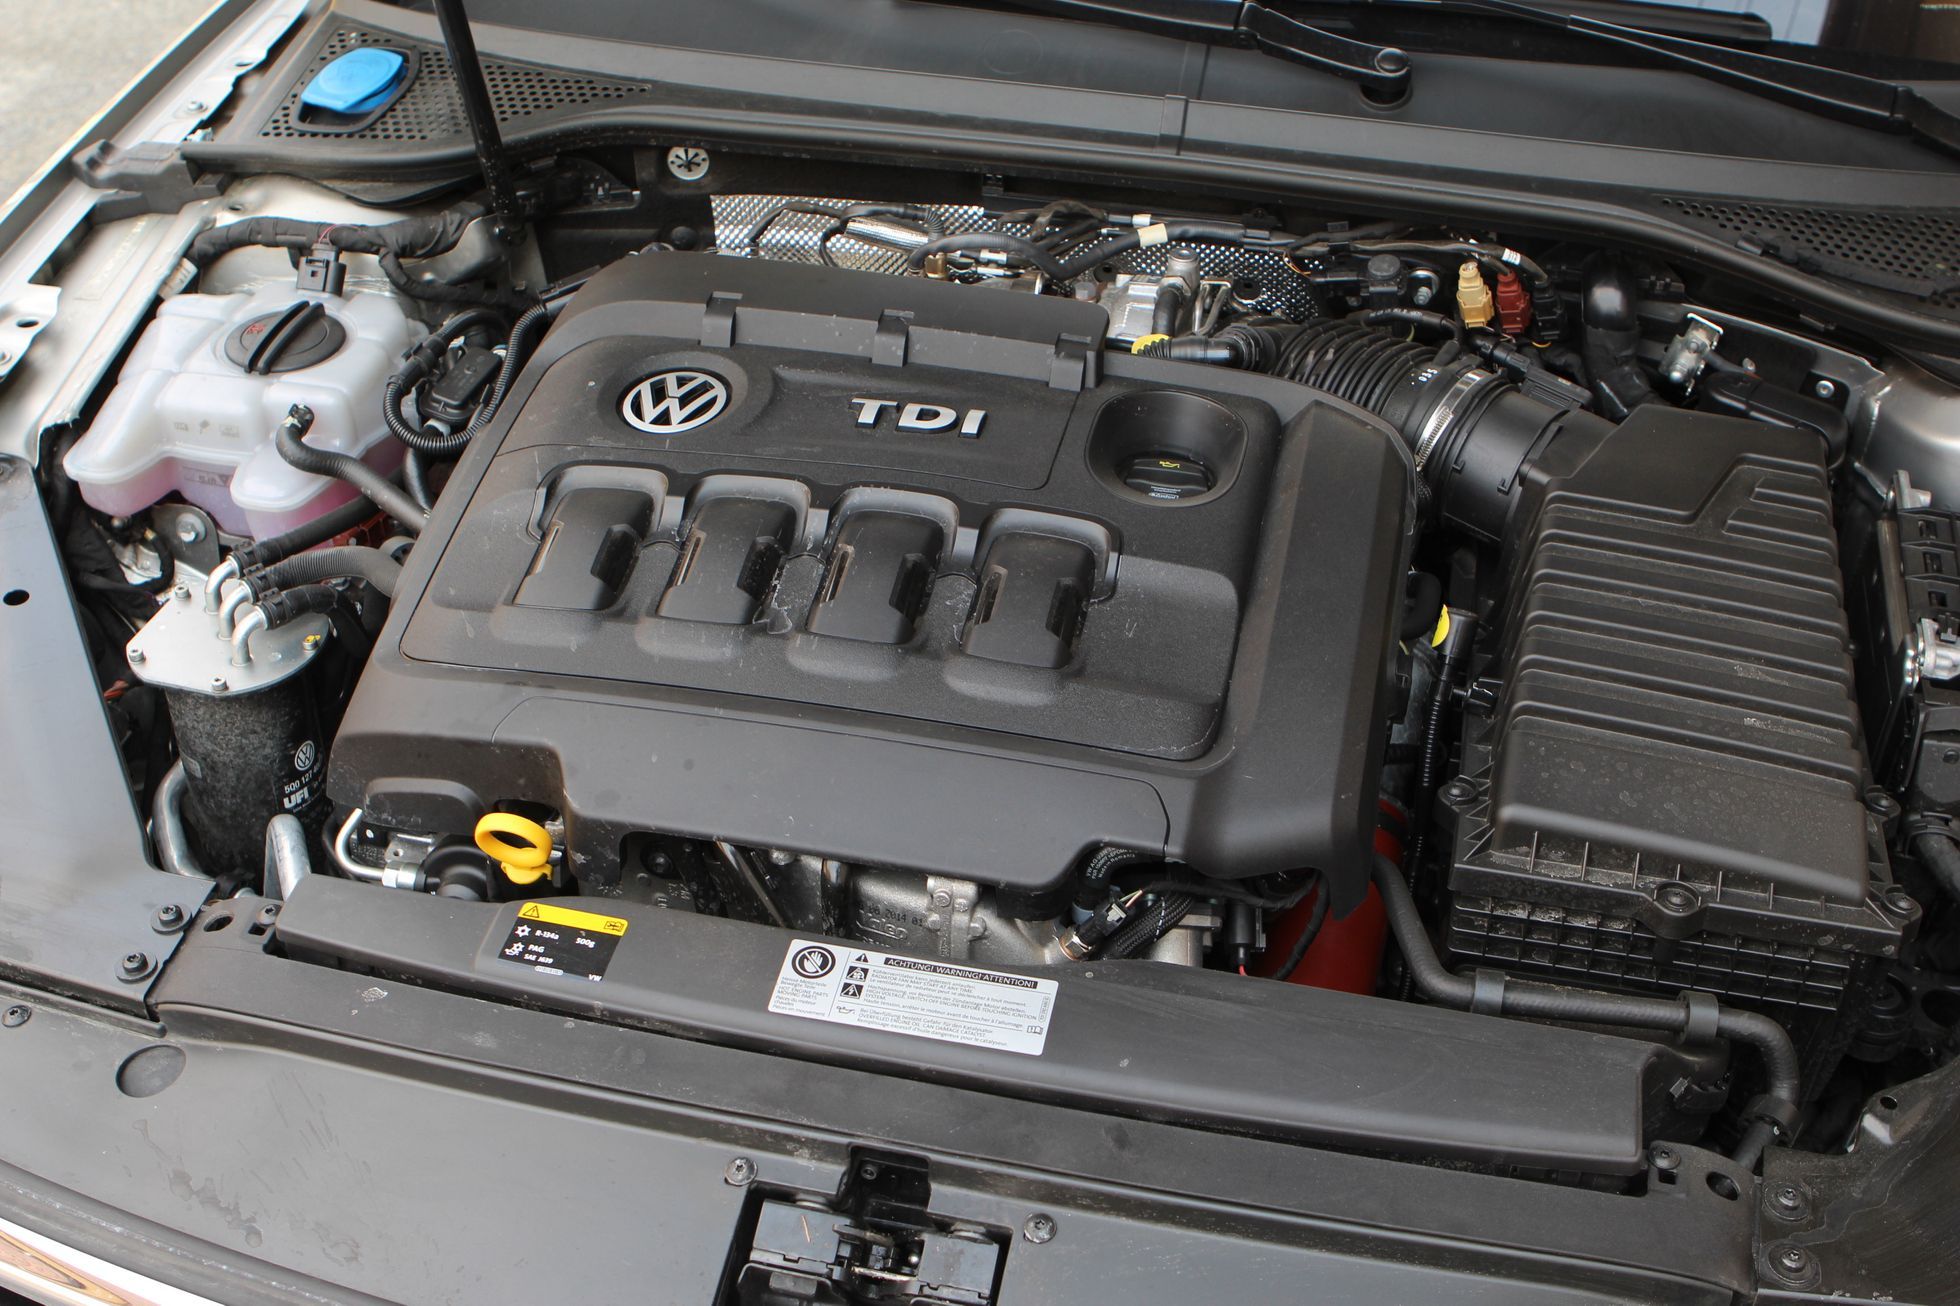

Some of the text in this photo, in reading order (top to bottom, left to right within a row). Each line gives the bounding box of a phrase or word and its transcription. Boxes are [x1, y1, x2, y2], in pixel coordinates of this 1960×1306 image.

[849, 397, 987, 437] TDI
[283, 786, 310, 809] UFI
[535, 929, 559, 940] R-134a
[528, 944, 545, 953] PAG
[576, 937, 596, 949] 500g
[524, 953, 536, 961] SAE
[588, 973, 602, 982] VW
[887, 959, 1034, 987] ACHTUNG! WARNING! ATTENTION!
